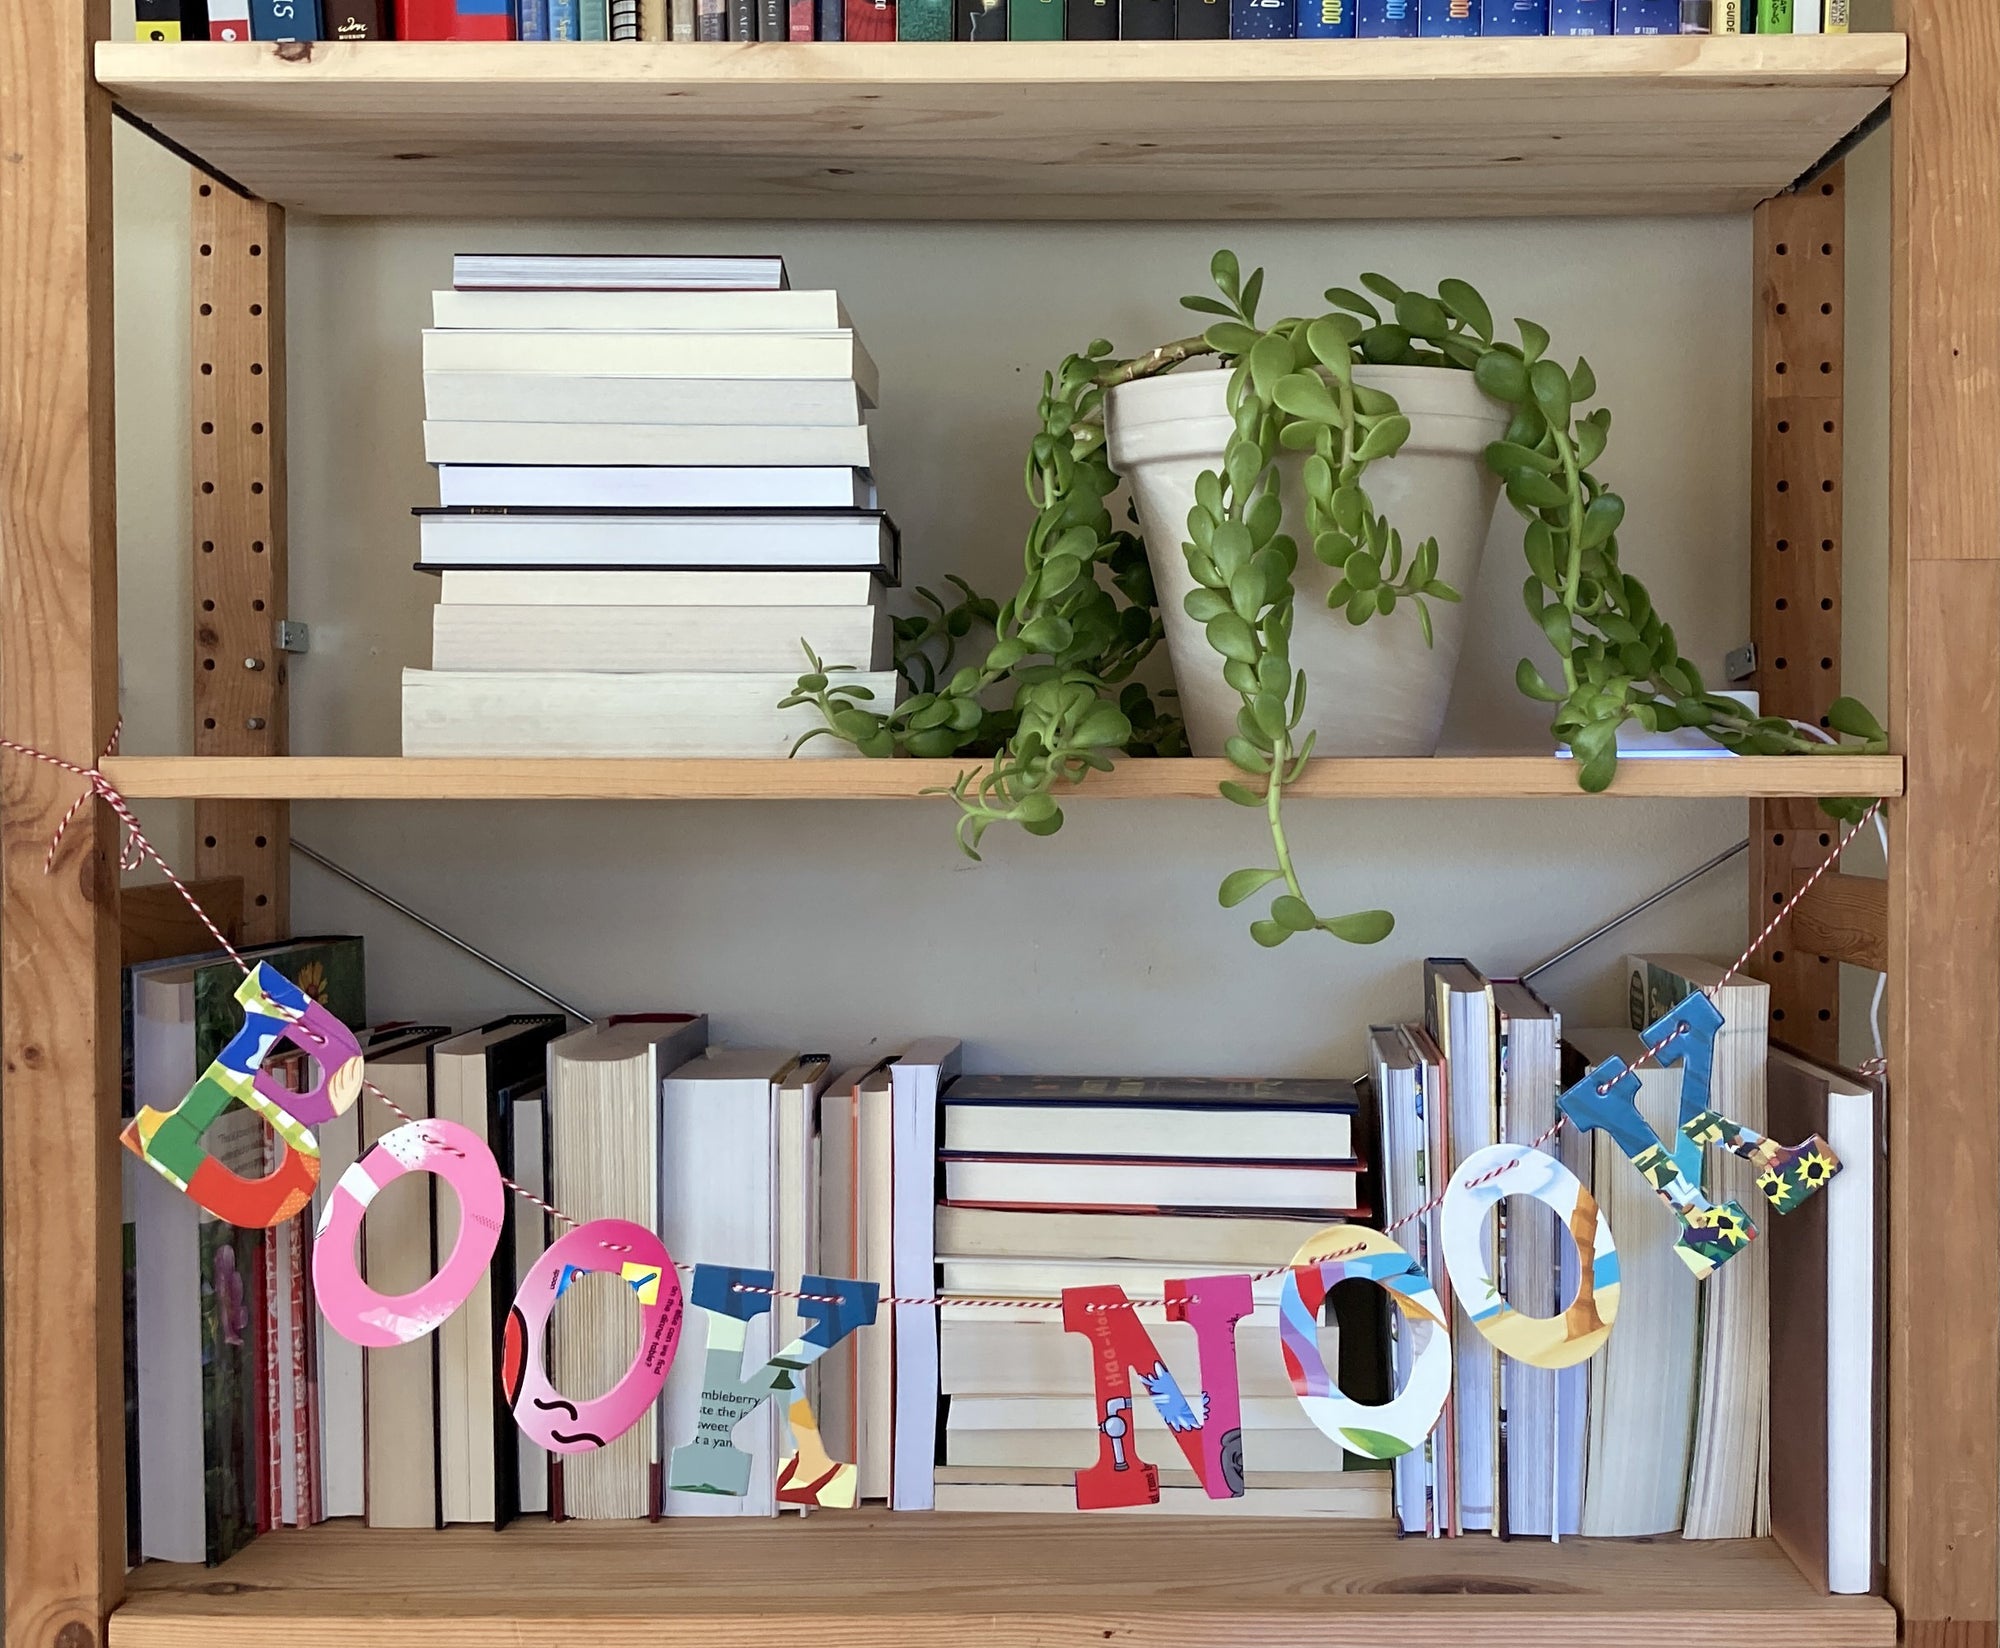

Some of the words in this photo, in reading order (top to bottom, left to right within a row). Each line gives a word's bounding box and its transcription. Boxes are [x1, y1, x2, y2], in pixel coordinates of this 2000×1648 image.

[1726, 2, 1736, 33] GUIDE
[119, 960, 880, 1509] BOOK
[1062, 990, 1844, 1509] NOOK
[718, 1406, 737, 1418] the
[703, 1437, 709, 1445] a
